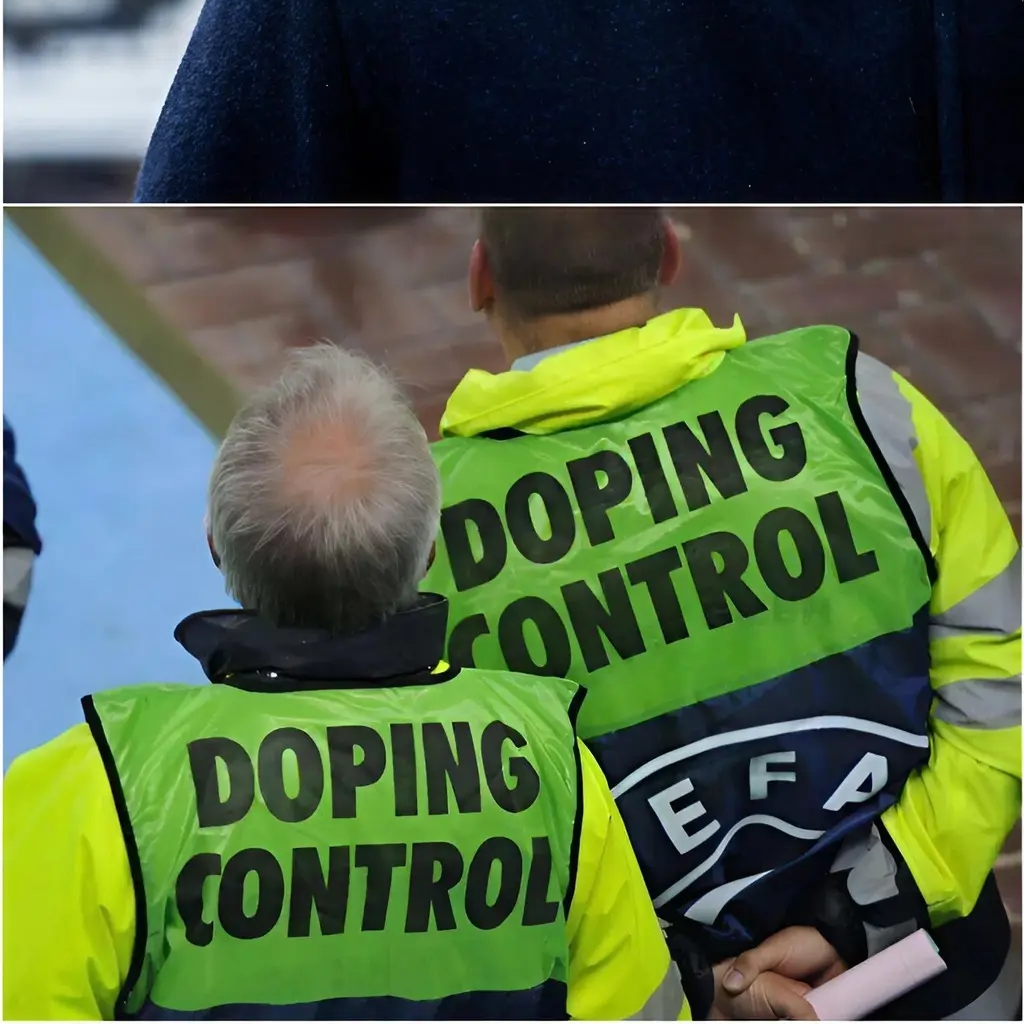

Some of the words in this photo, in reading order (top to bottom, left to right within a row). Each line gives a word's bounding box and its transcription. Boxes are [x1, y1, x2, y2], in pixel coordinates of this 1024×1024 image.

[440, 394, 807, 592] DOPING
[447, 491, 880, 678] CONTROL
[187, 720, 541, 828] DOPING
[175, 836, 560, 947] CONTROL
